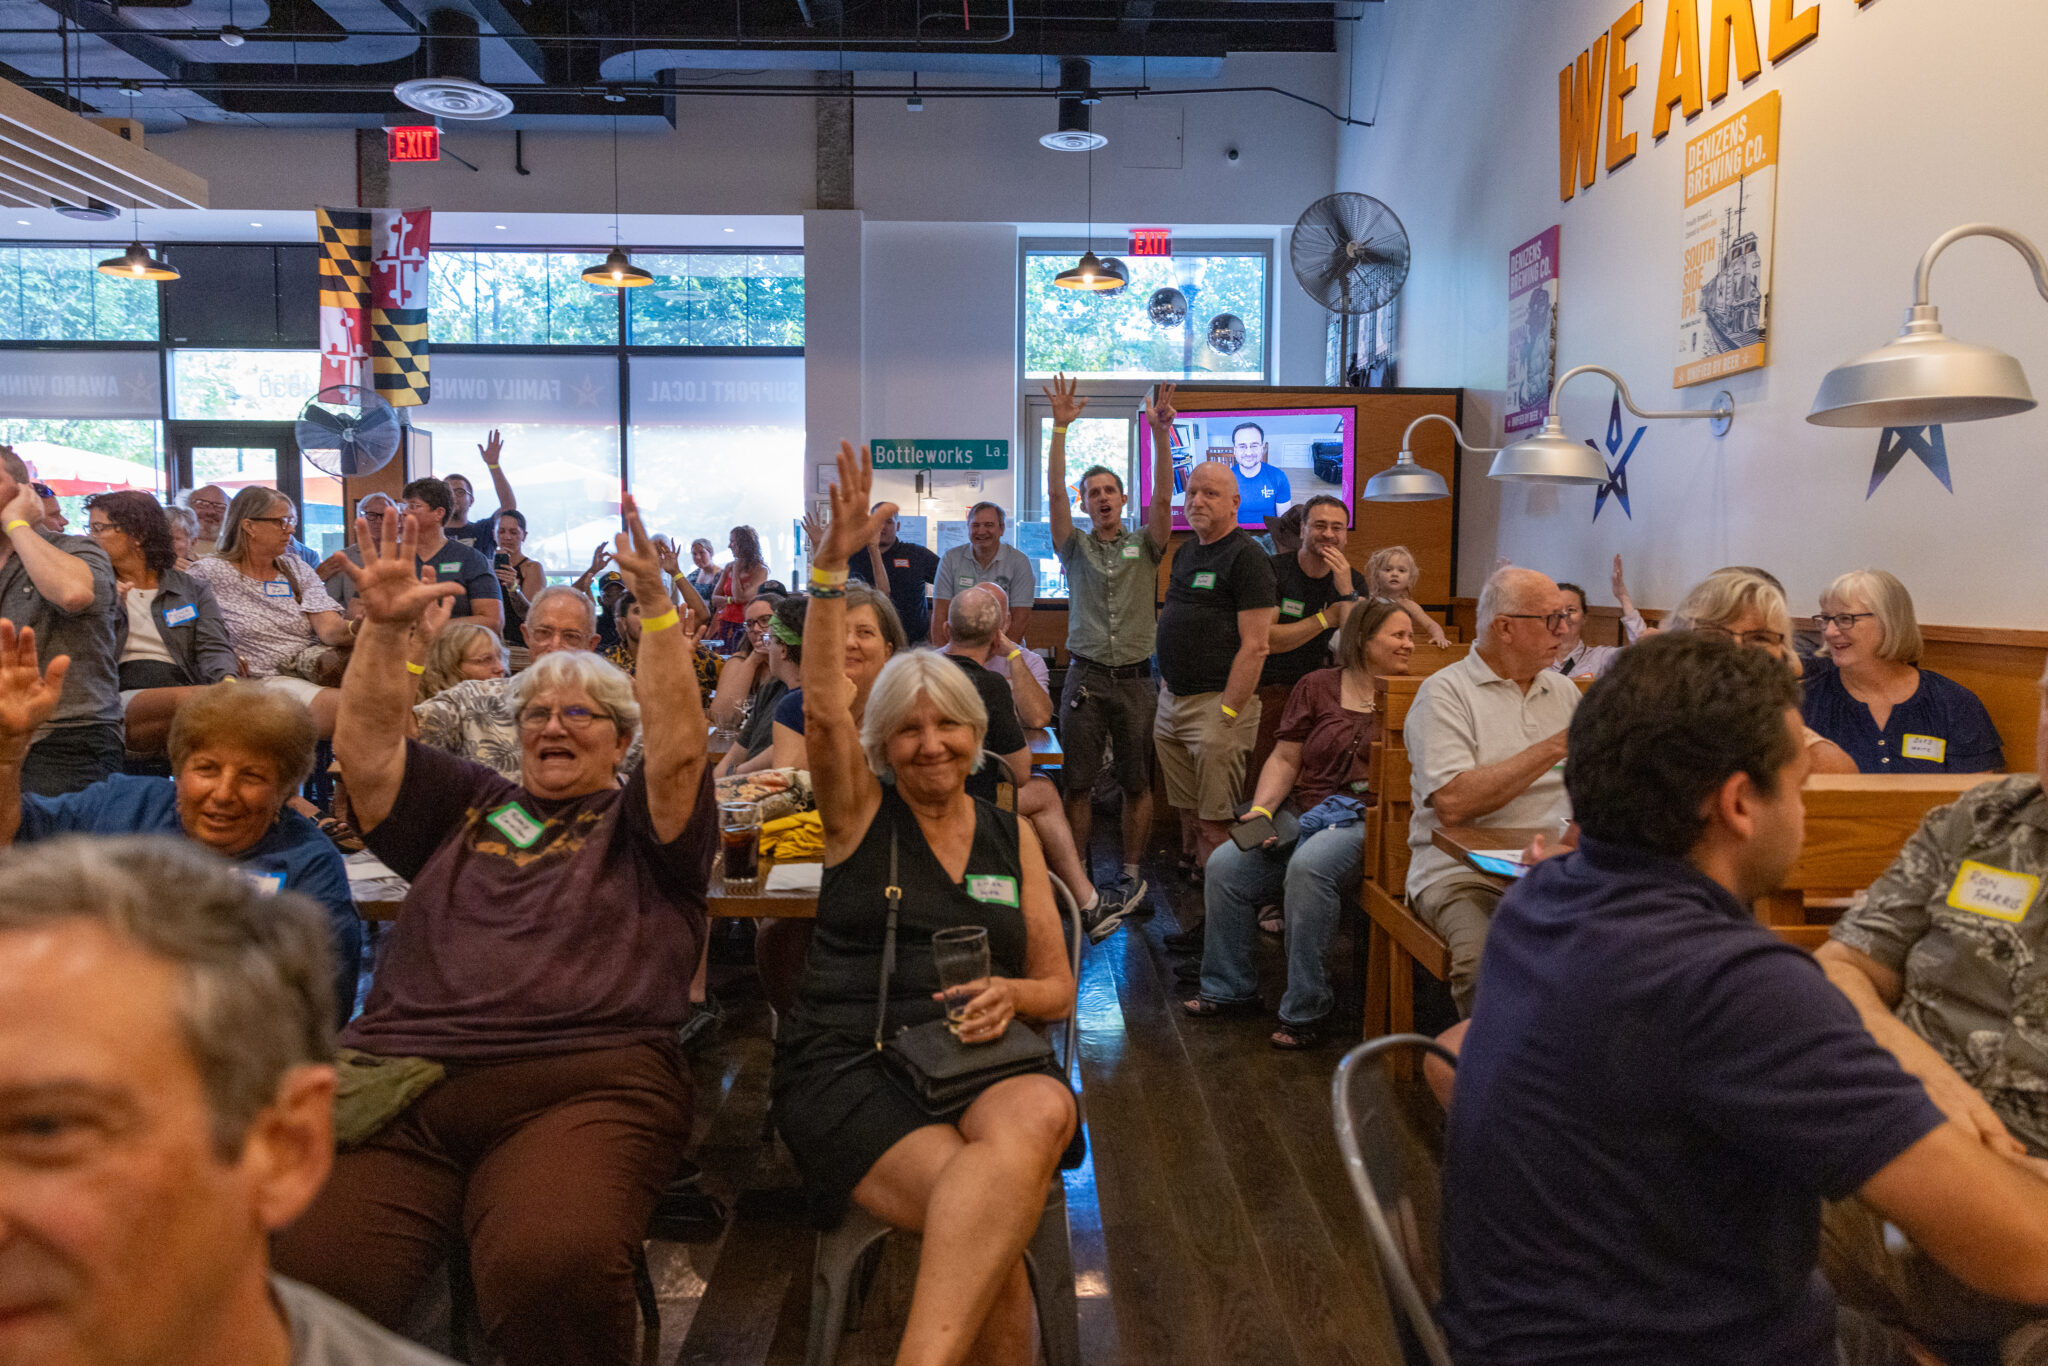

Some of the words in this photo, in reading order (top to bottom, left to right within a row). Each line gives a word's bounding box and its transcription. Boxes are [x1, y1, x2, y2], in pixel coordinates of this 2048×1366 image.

[1559, 0, 1643, 203] WE
[1652, 0, 1820, 139] AR
[396, 131, 433, 158] EXIT
[1688, 114, 1747, 172] DENIZENS
[1687, 146, 1742, 199] BREWING
[1745, 134, 1766, 168] CO.
[1135, 231, 1168, 255] EXIT
[1511, 239, 1542, 275] DENIZENS
[1684, 237, 1716, 272] SOUTH
[1511, 261, 1539, 295] BREWING
[1540, 256, 1552, 278] CO.
[1682, 265, 1704, 296] SIDE
[1682, 293, 1696, 320] IPA
[1722, 353, 1740, 371] BEER
[876, 445, 973, 464] Bottleworks
